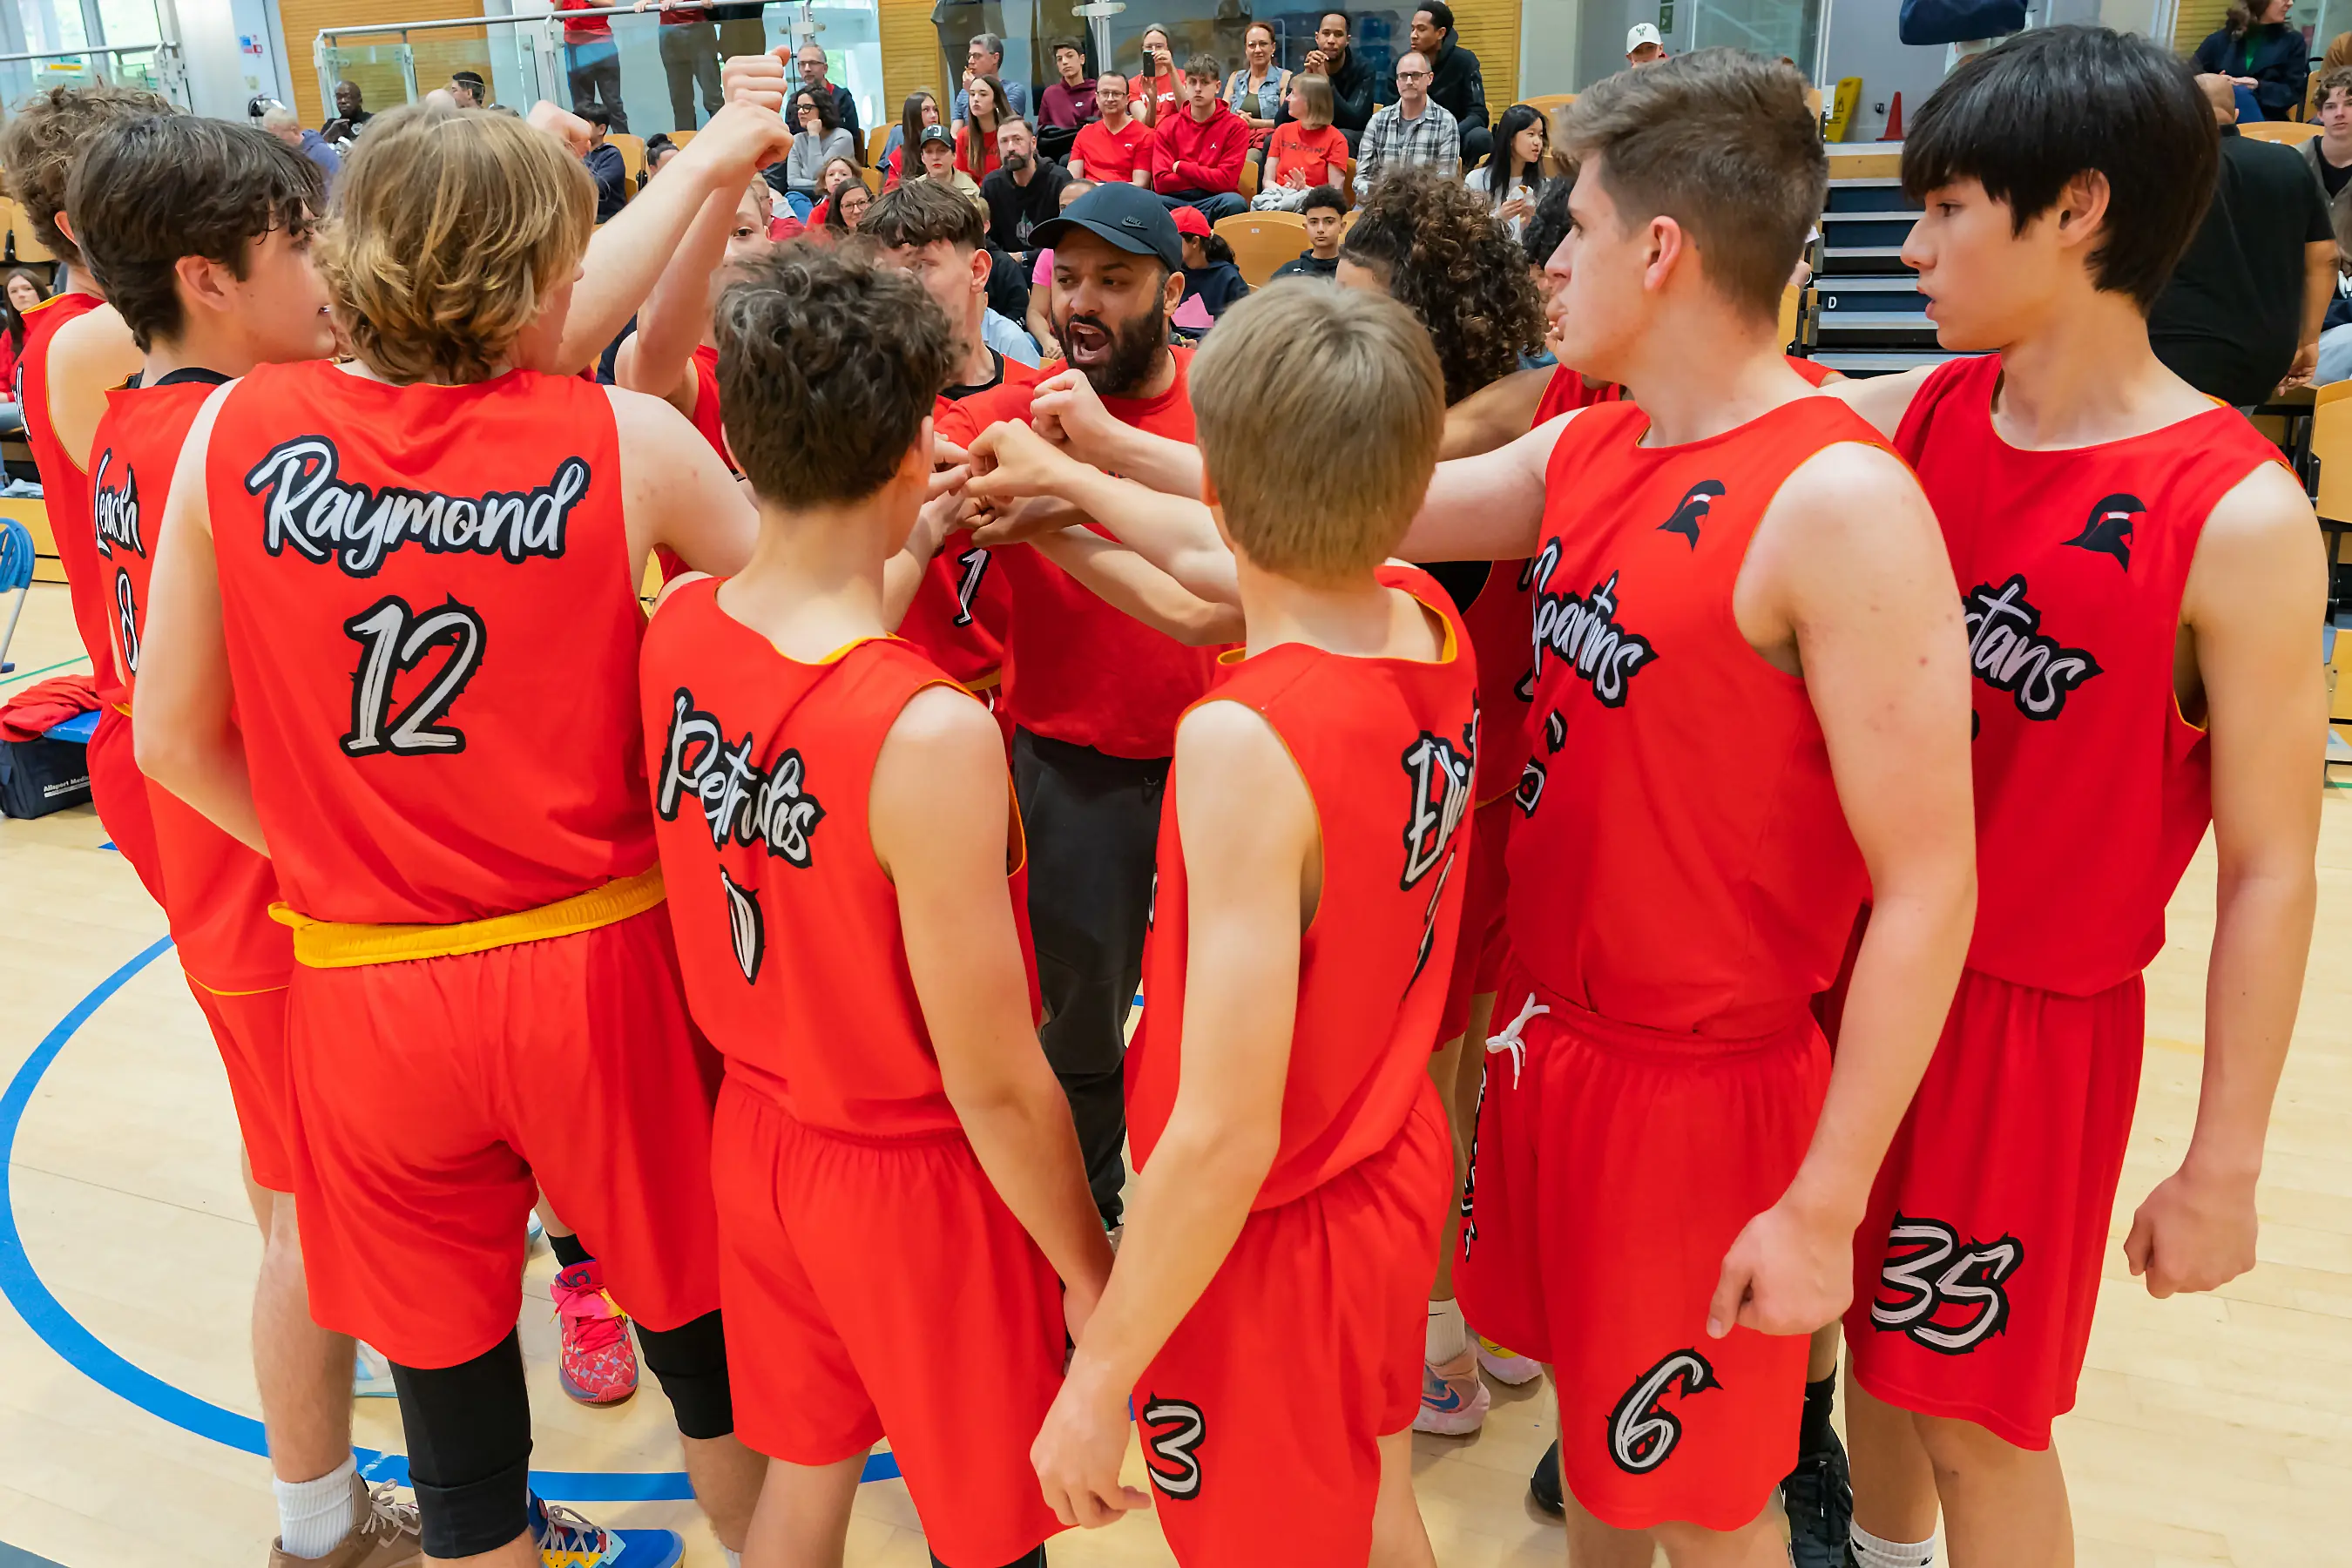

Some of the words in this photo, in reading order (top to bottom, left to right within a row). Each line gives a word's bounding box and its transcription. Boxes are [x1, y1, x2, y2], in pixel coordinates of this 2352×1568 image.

[1828, 296, 1837, 309] D
[95, 448, 146, 560] Leach
[245, 436, 591, 578] Raymond
[116, 566, 139, 677] 8
[953, 547, 992, 627] 1
[340, 592, 486, 757] 12
[1870, 1210, 2024, 1355] 35
[1143, 1391, 1206, 1500] 3
[1605, 1347, 1724, 1475] 6
